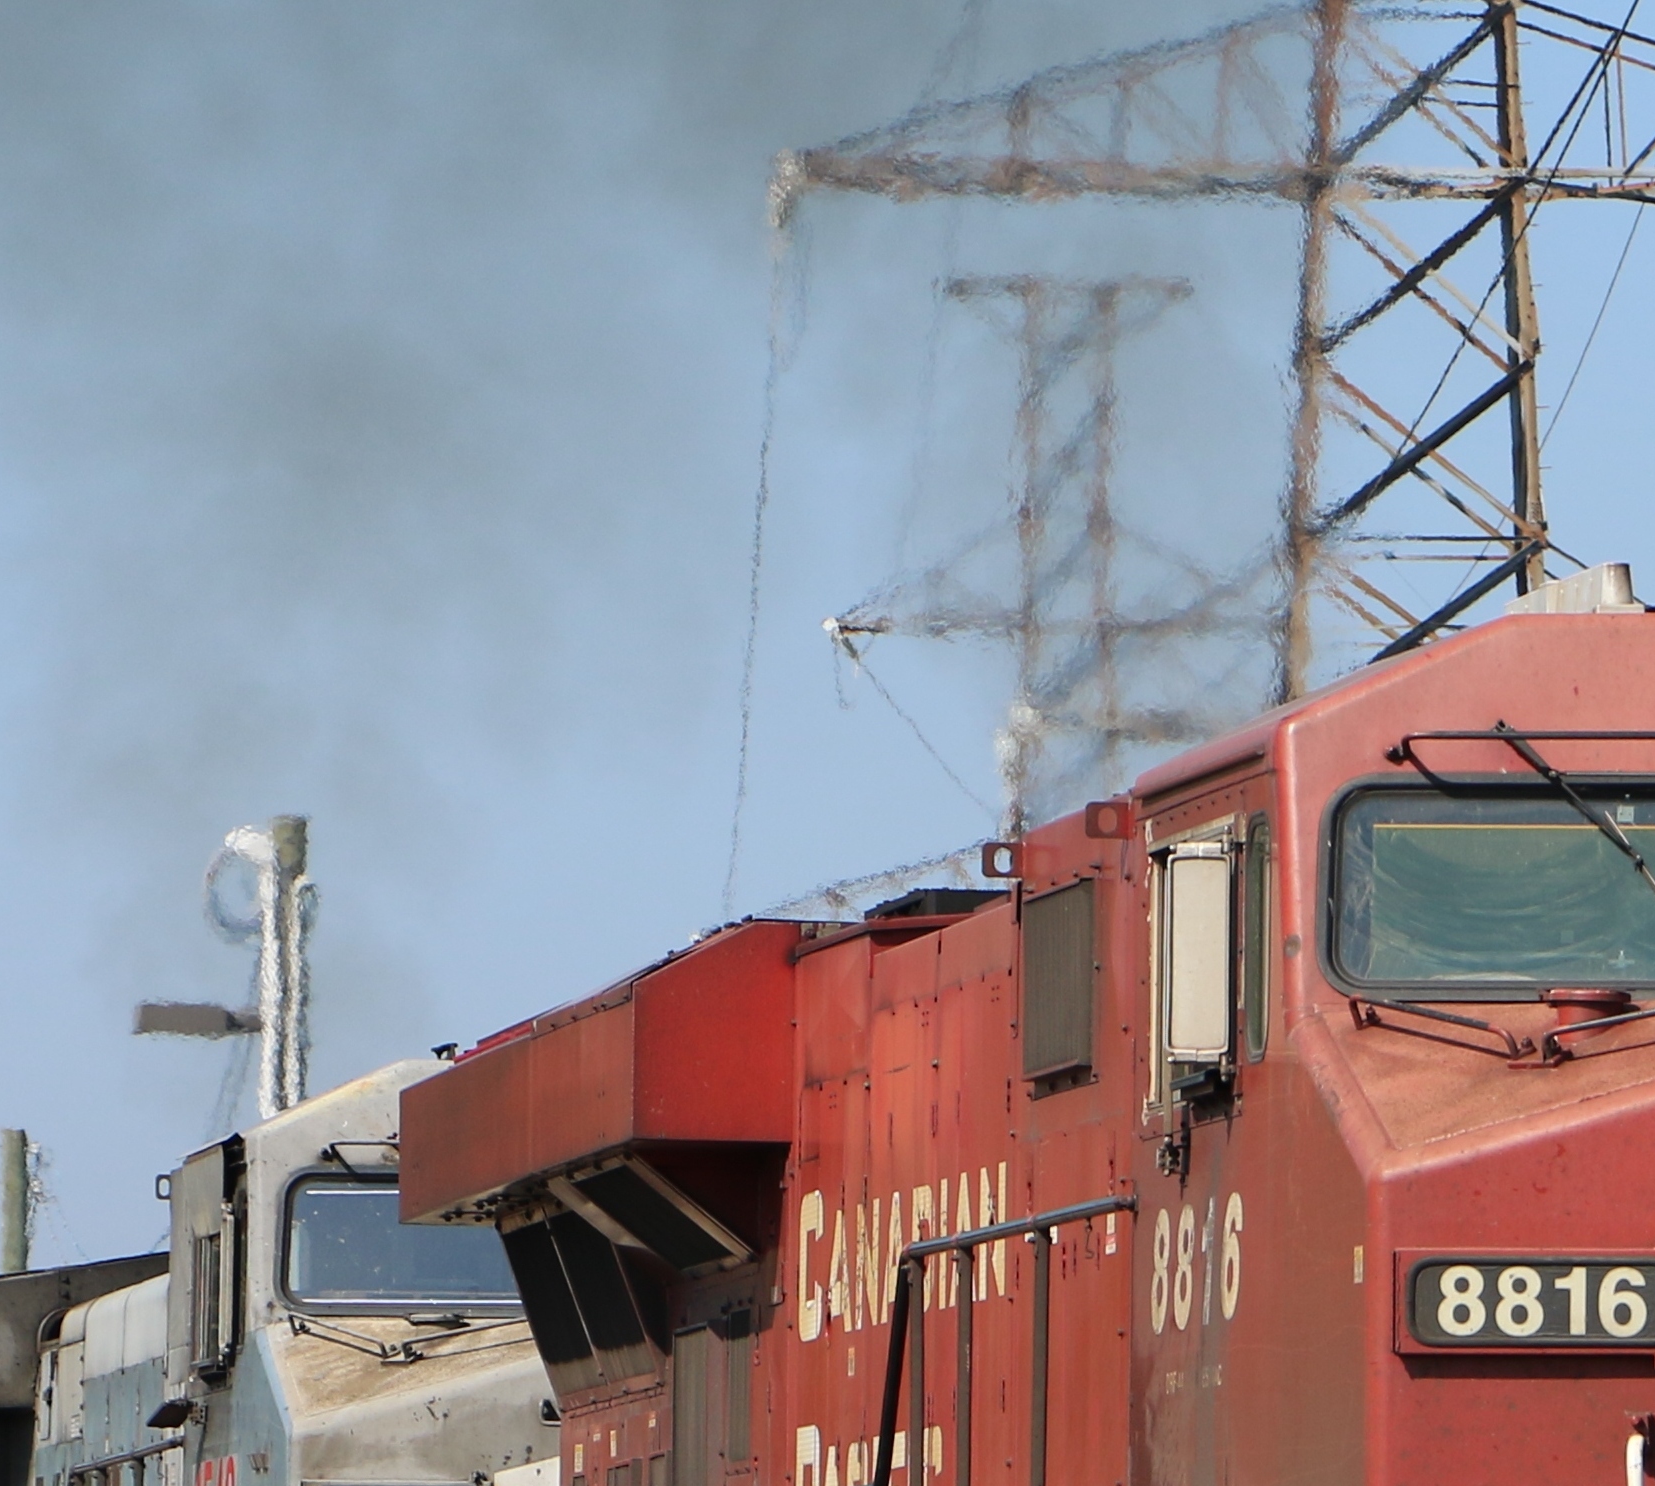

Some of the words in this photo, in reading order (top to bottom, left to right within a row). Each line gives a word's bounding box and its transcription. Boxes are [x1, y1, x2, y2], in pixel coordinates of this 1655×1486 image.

[799, 1161, 1007, 1342] CANADIAN
[1149, 1192, 1243, 1335] 8816
[1437, 1265, 1647, 1337] 8816
